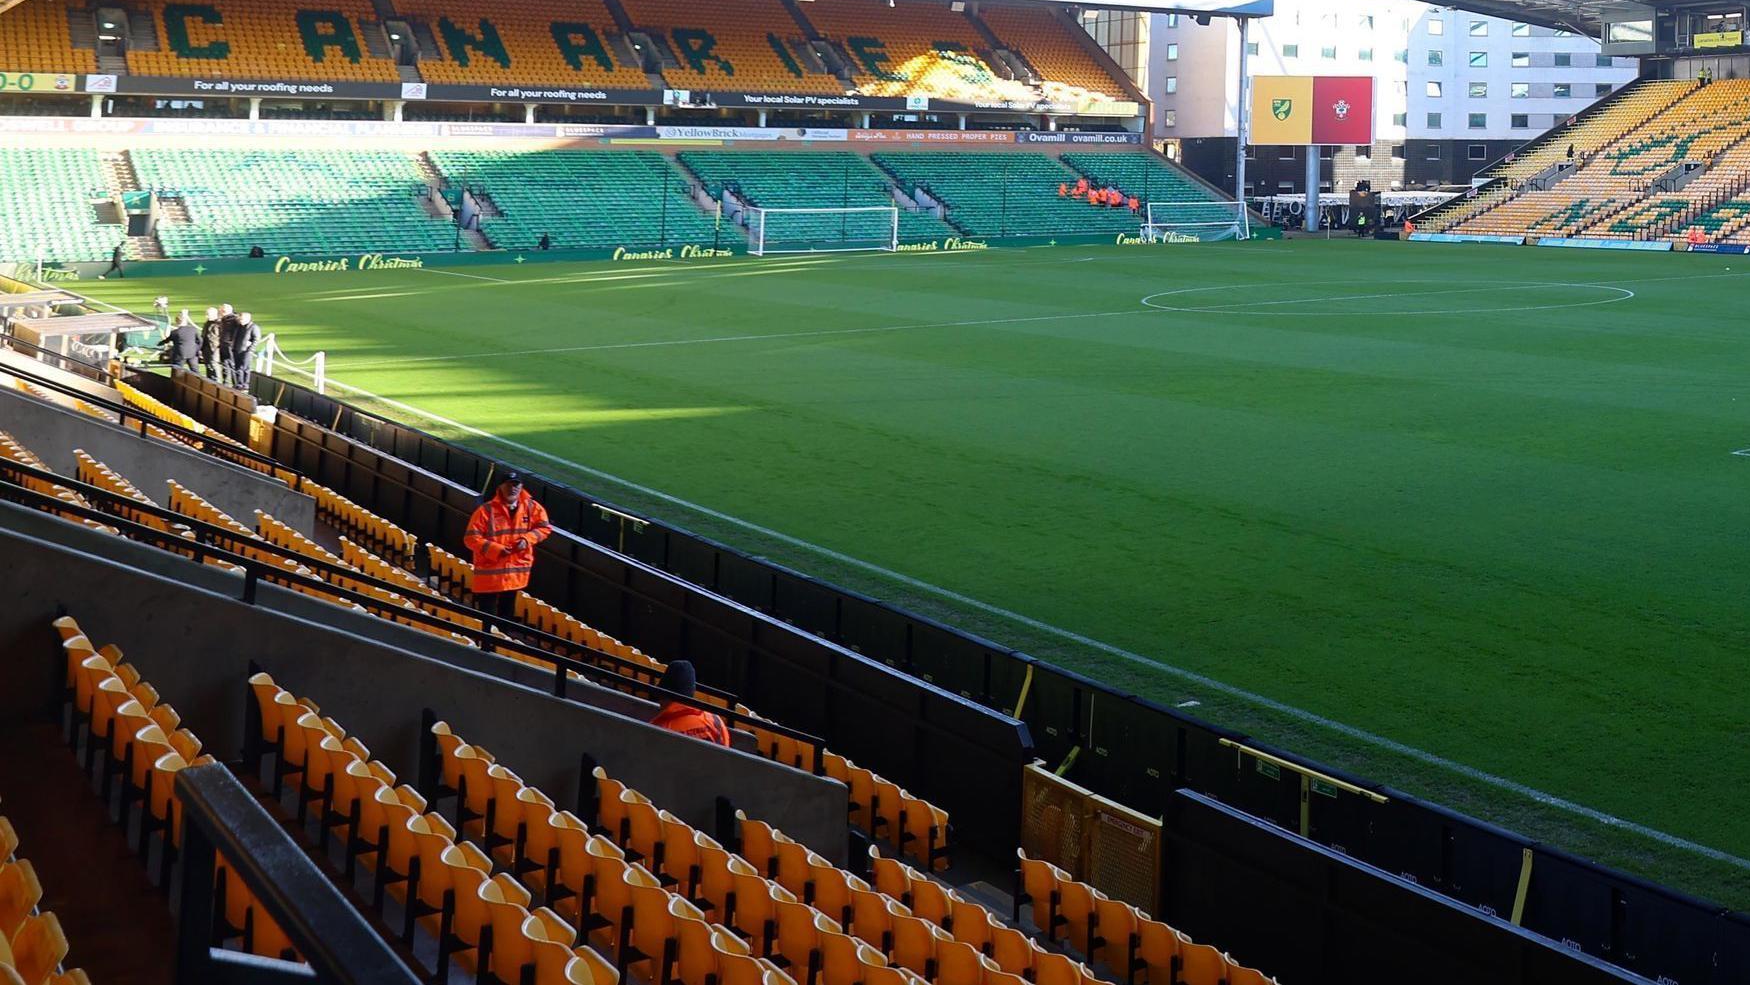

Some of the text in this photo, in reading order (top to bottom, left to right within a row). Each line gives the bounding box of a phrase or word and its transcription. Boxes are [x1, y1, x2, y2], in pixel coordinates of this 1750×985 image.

[194, 80, 333, 94] For all your roofing needs
[490, 88, 606, 100] For all your roofing needs
[744, 95, 859, 106] Your local Solar PV specialists
[677, 128, 740, 138] YellowBrick
[961, 133, 987, 141] PROPER
[1029, 133, 1128, 143] Ovamill ovamill.co.uk
[896, 240, 937, 252] anaries
[613, 246, 672, 261] Canaries
[274, 253, 423, 274] Canaries Christmas
